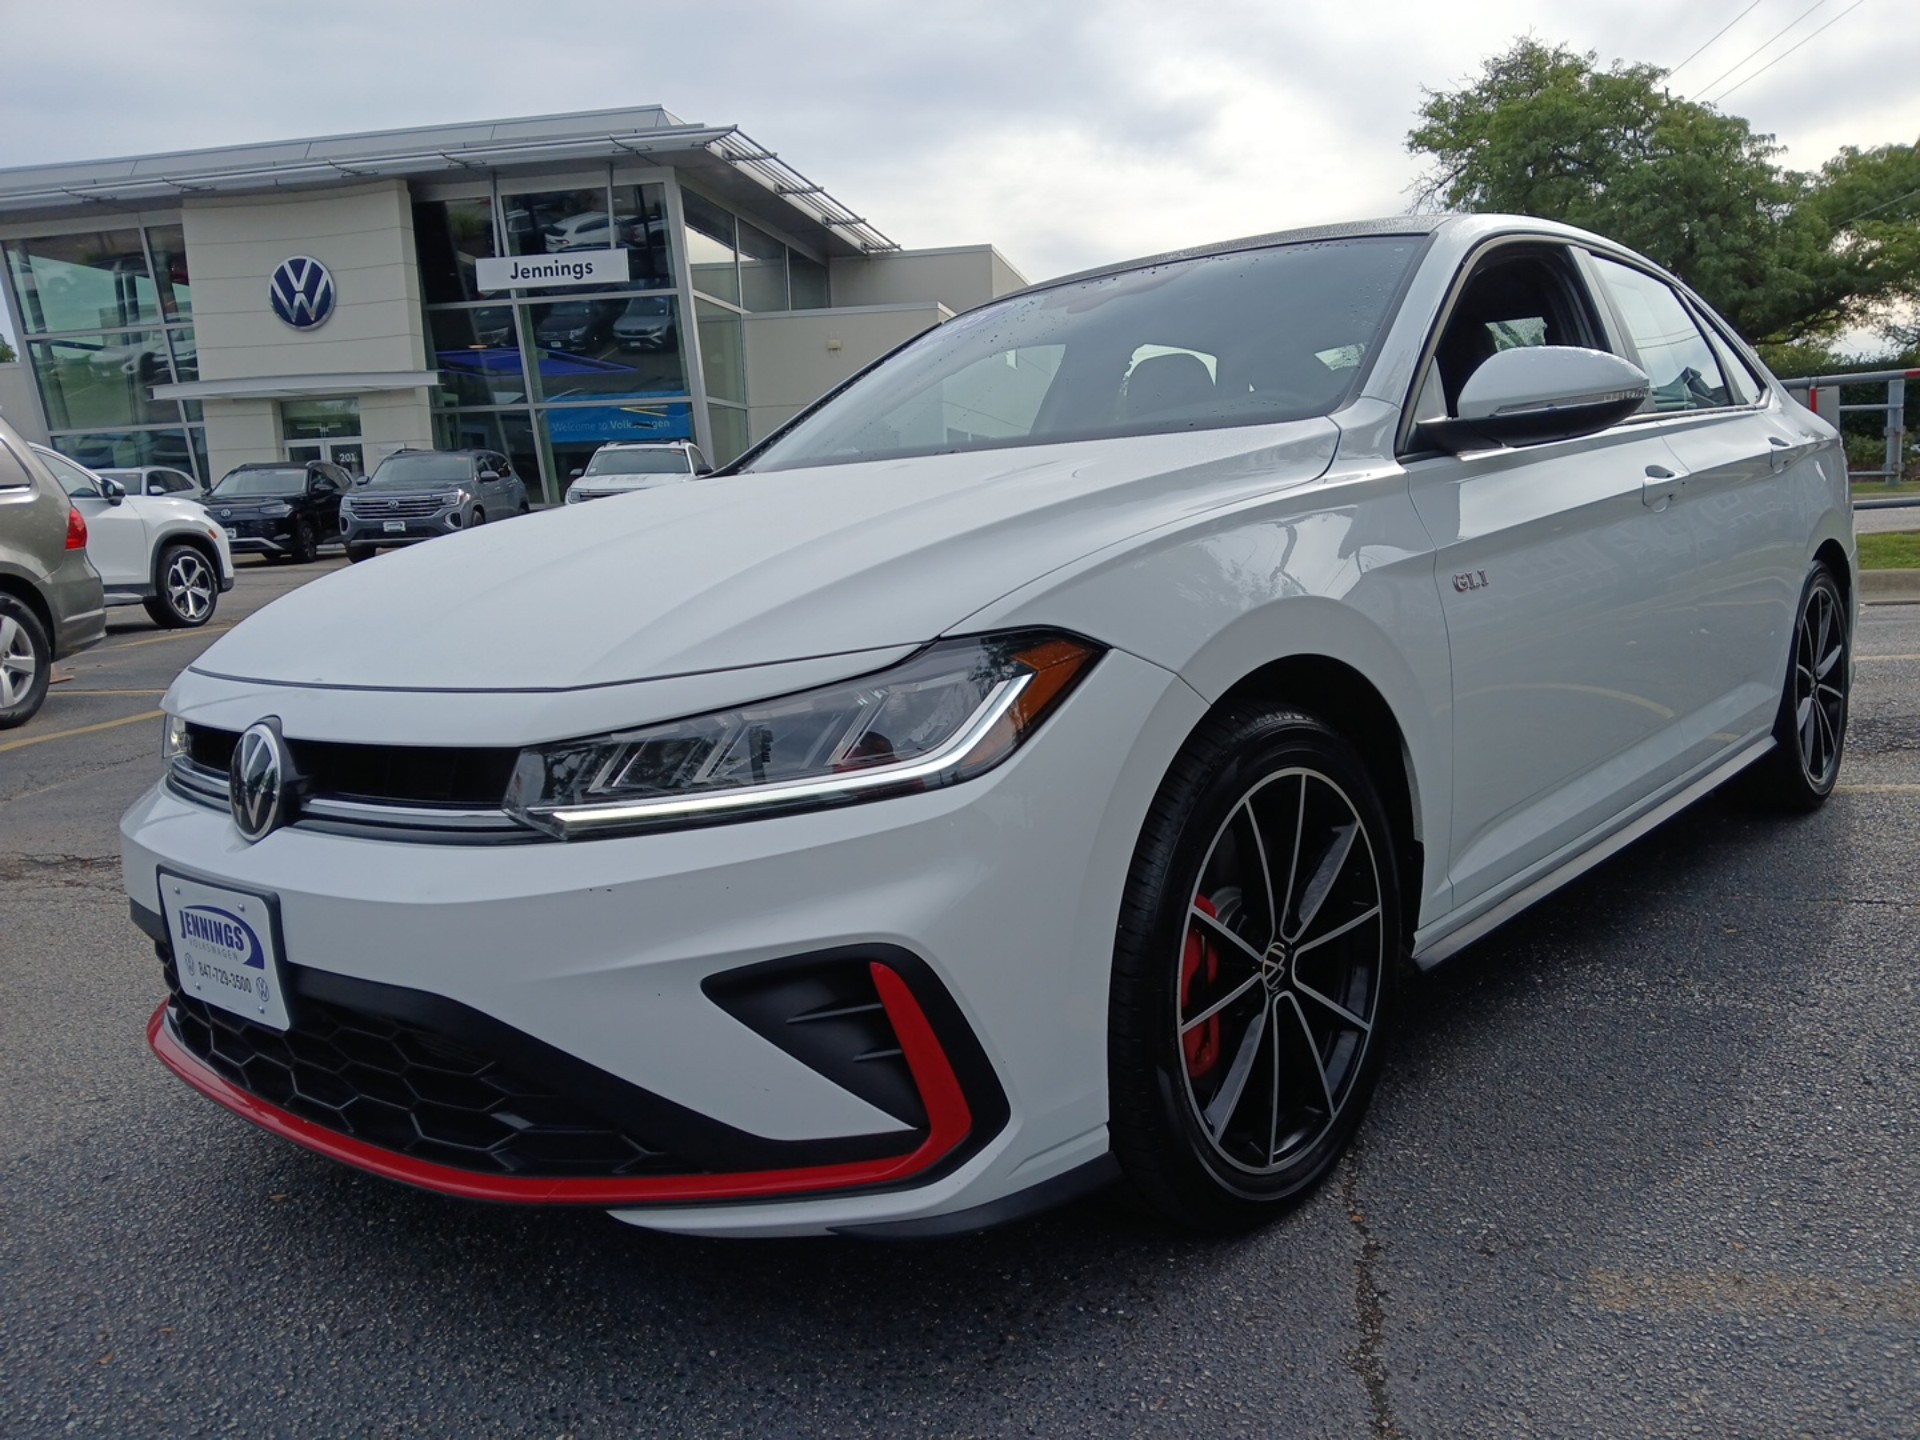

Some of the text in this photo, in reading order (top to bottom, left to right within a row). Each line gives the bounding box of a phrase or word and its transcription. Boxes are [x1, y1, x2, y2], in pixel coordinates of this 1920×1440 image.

[510, 259, 594, 281] Jennings
[551, 419, 597, 433] Welcome
[609, 418, 671, 431] Volkgen
[339, 453, 356, 463] 201
[1452, 568, 1489, 593] GLI
[178, 909, 245, 952] JENNINGS
[188, 939, 239, 961] VOLKSWAGEN
[197, 961, 252, 994] 847-729-3500
